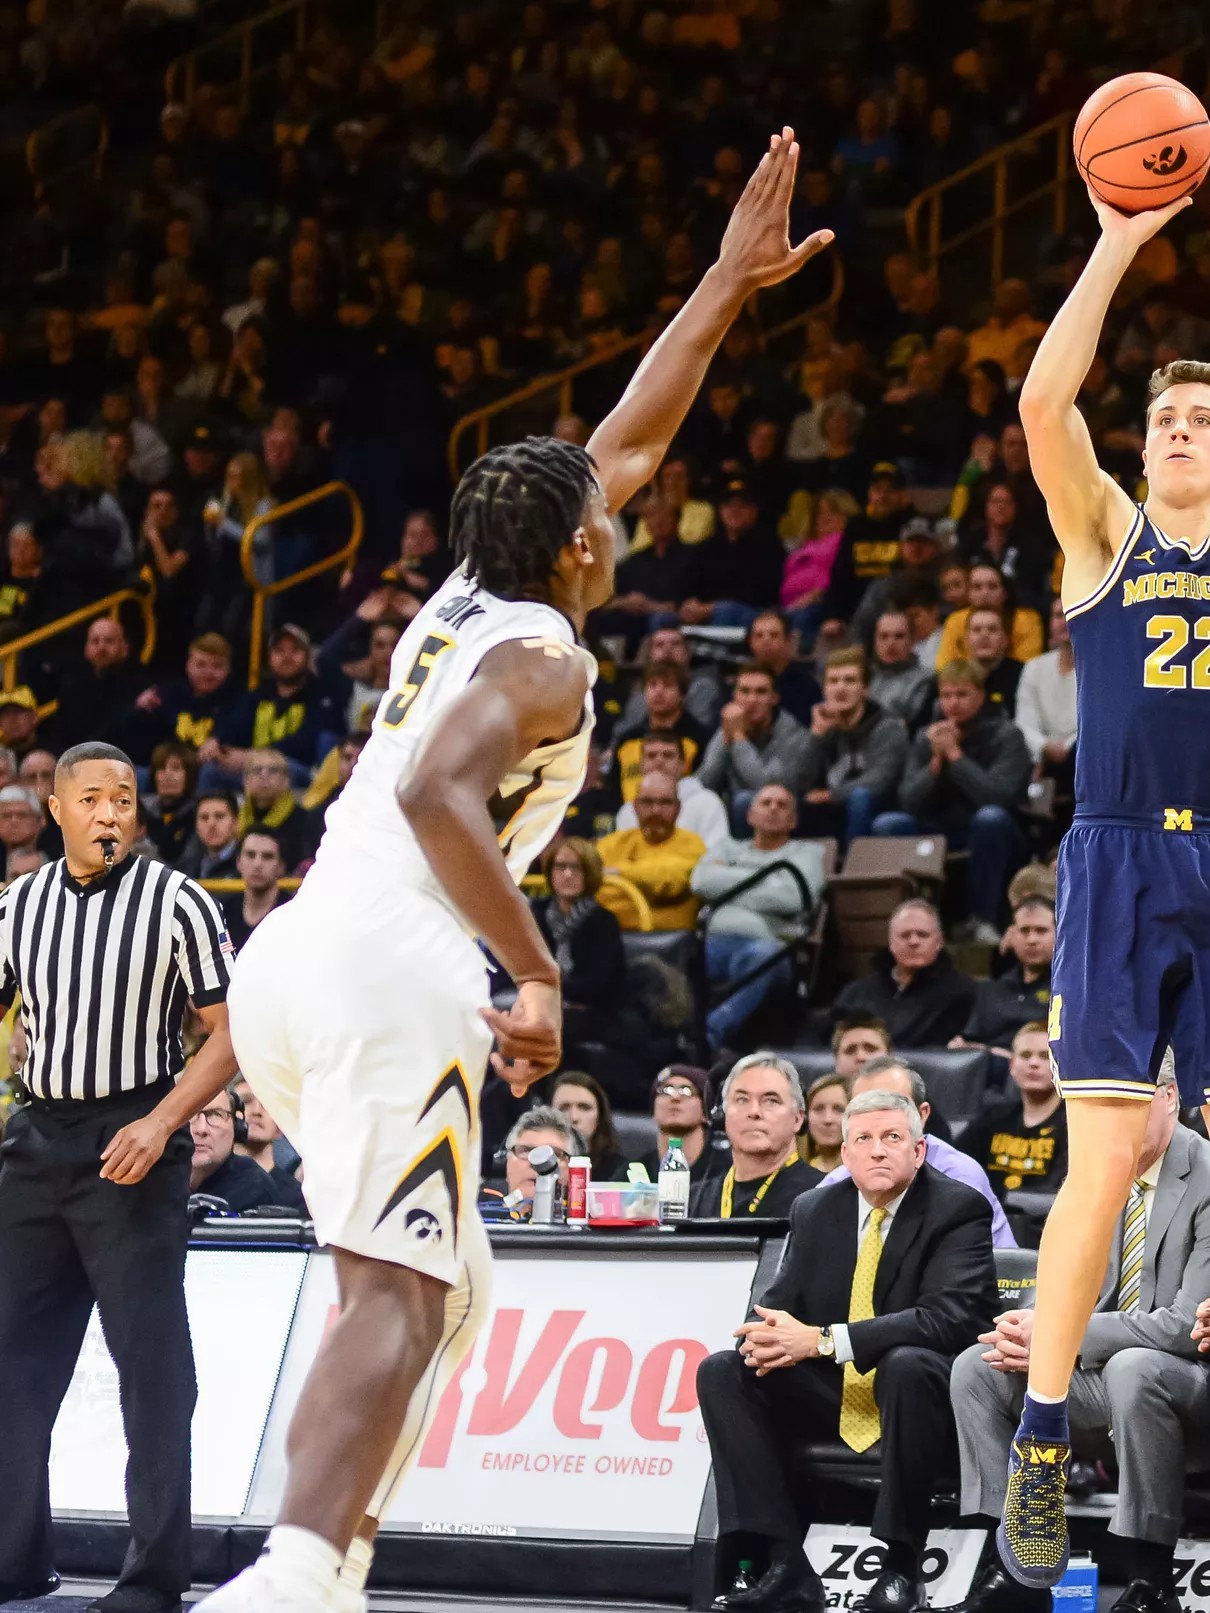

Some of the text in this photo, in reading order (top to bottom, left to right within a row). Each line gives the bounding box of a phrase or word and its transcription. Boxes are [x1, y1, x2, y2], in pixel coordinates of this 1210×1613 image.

[383, 631, 457, 730] 5
[1163, 808, 1193, 831] M
[481, 1452, 673, 1476] EMPLOYEE OWNED
[1029, 1446, 1057, 1465] M
[421, 1521, 517, 1536] DAKTRONICS
[820, 1544, 949, 1584] zeo
